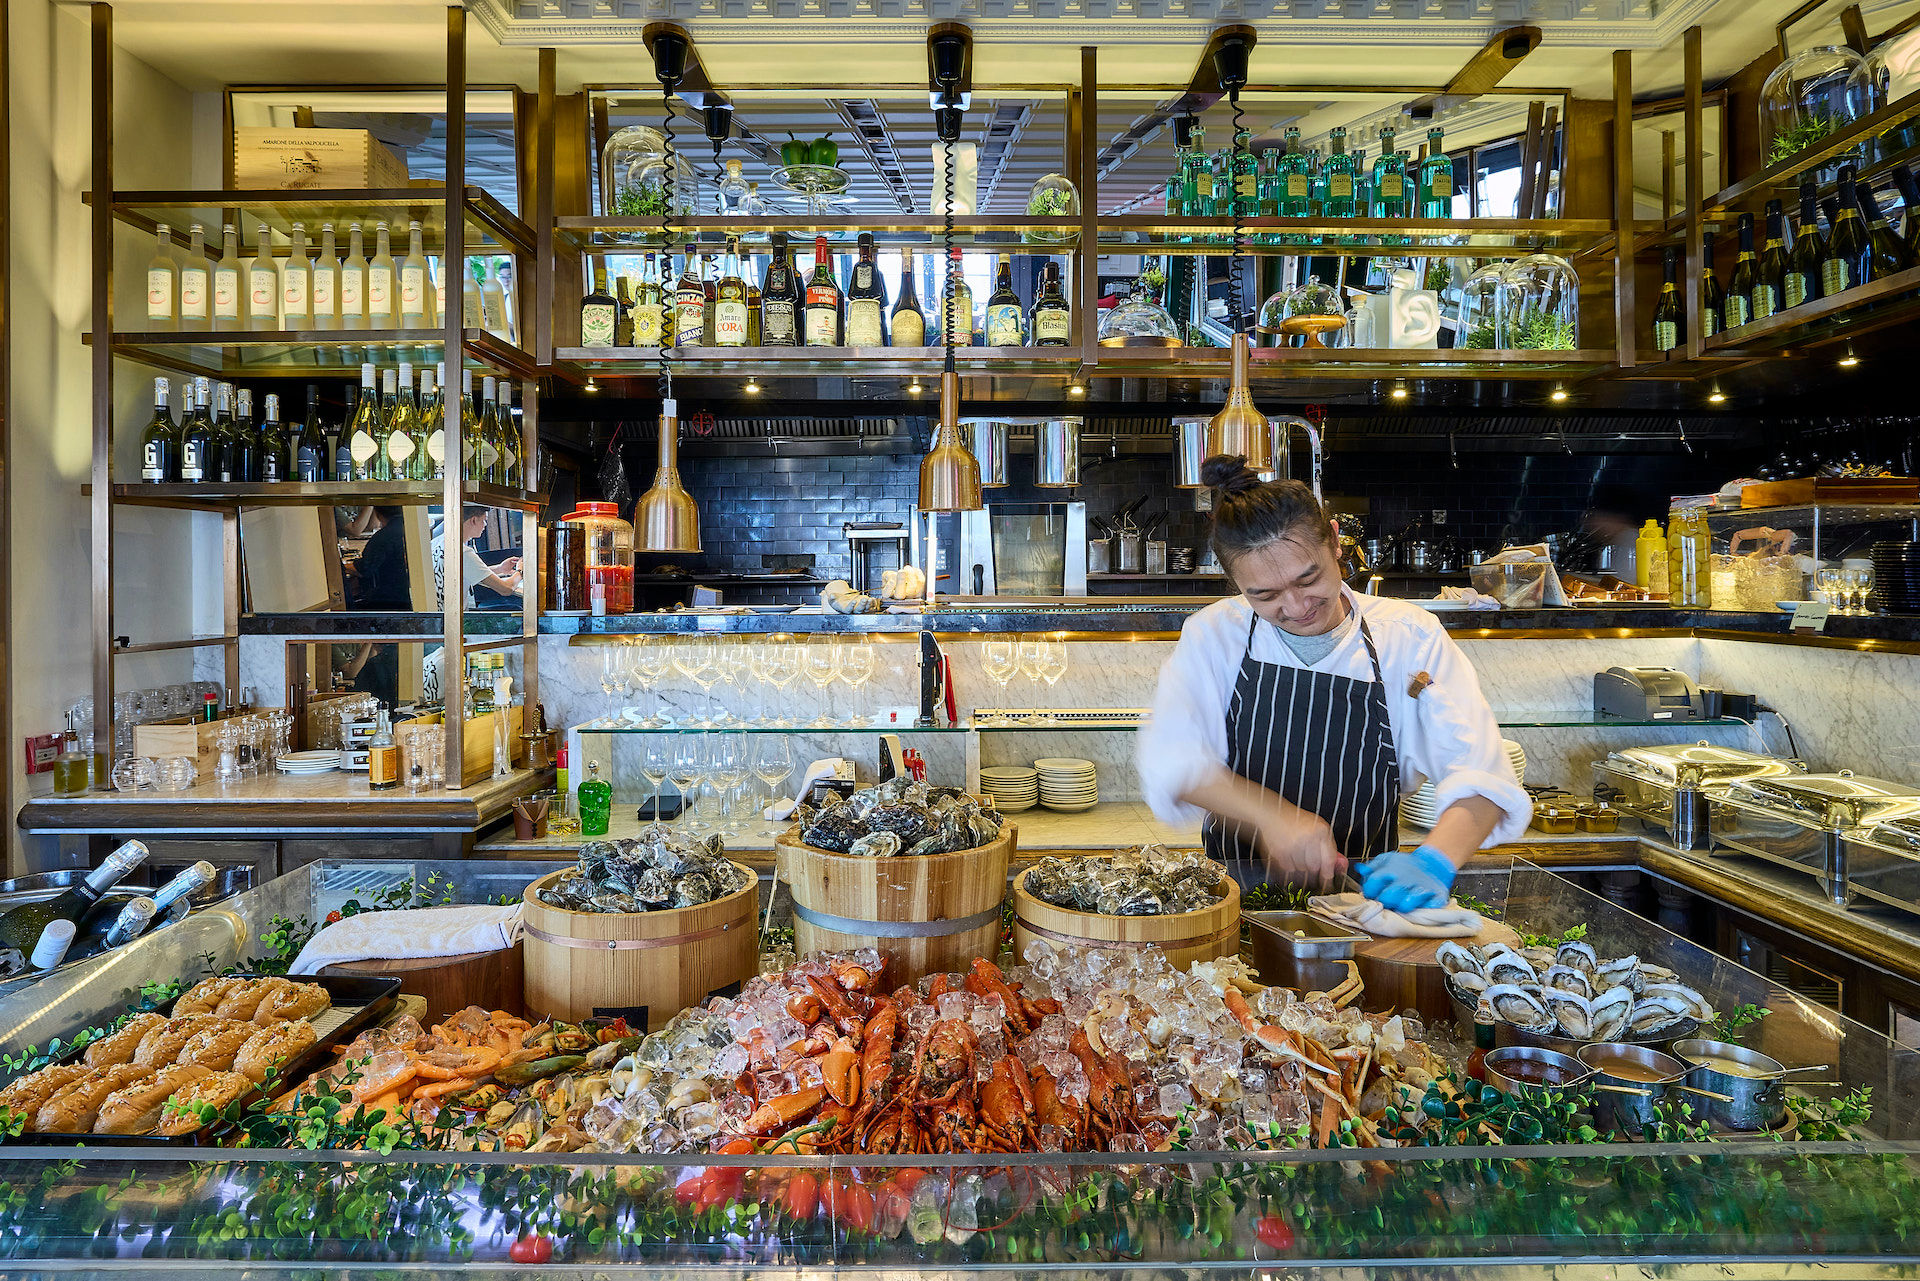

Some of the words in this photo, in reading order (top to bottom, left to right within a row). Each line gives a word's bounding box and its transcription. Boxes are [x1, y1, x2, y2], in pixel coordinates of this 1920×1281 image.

[720, 313, 741, 321] Amaro
[716, 322, 743, 333] CORA
[1042, 321, 1066, 330] Blasius
[144, 442, 157, 465] G
[184, 442, 196, 465] G
